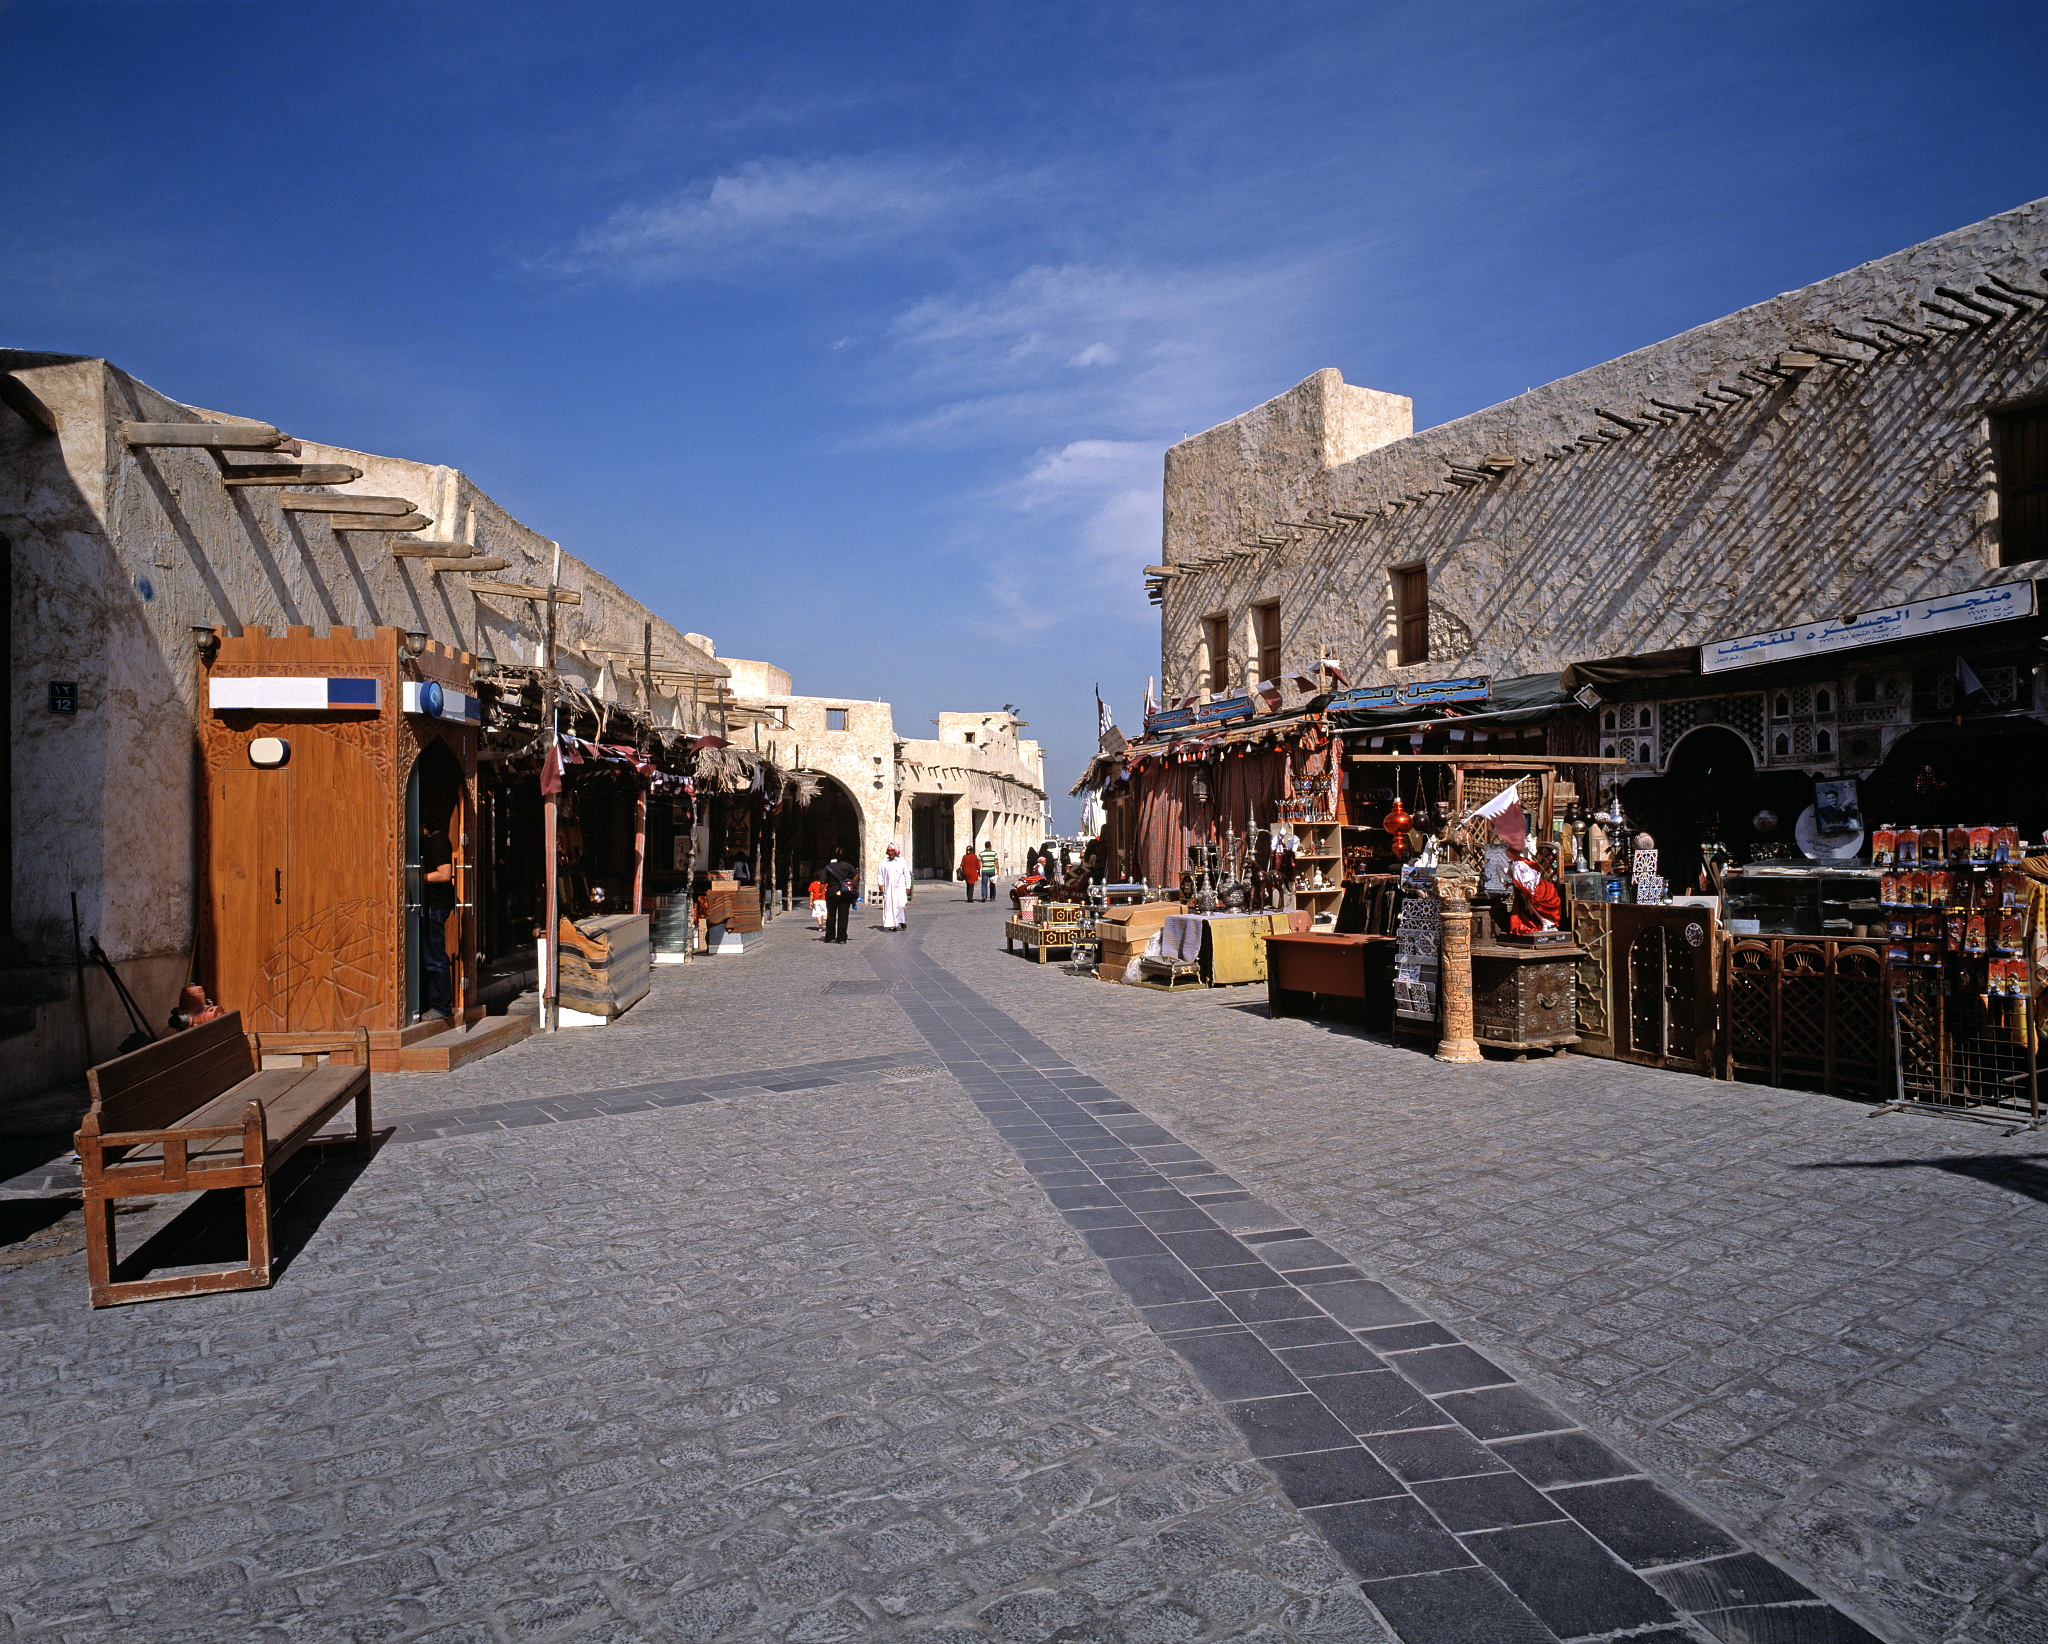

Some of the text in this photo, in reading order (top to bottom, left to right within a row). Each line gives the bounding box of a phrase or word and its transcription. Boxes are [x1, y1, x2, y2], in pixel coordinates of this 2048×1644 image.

[1717, 589, 2012, 655] متجر الجسره للتحف
[55, 685, 71, 695] ١٢
[1331, 676, 1488, 703] فحيحيل للتراث
[55, 699, 71, 710] 12
[1200, 698, 1250, 717] أسواق
